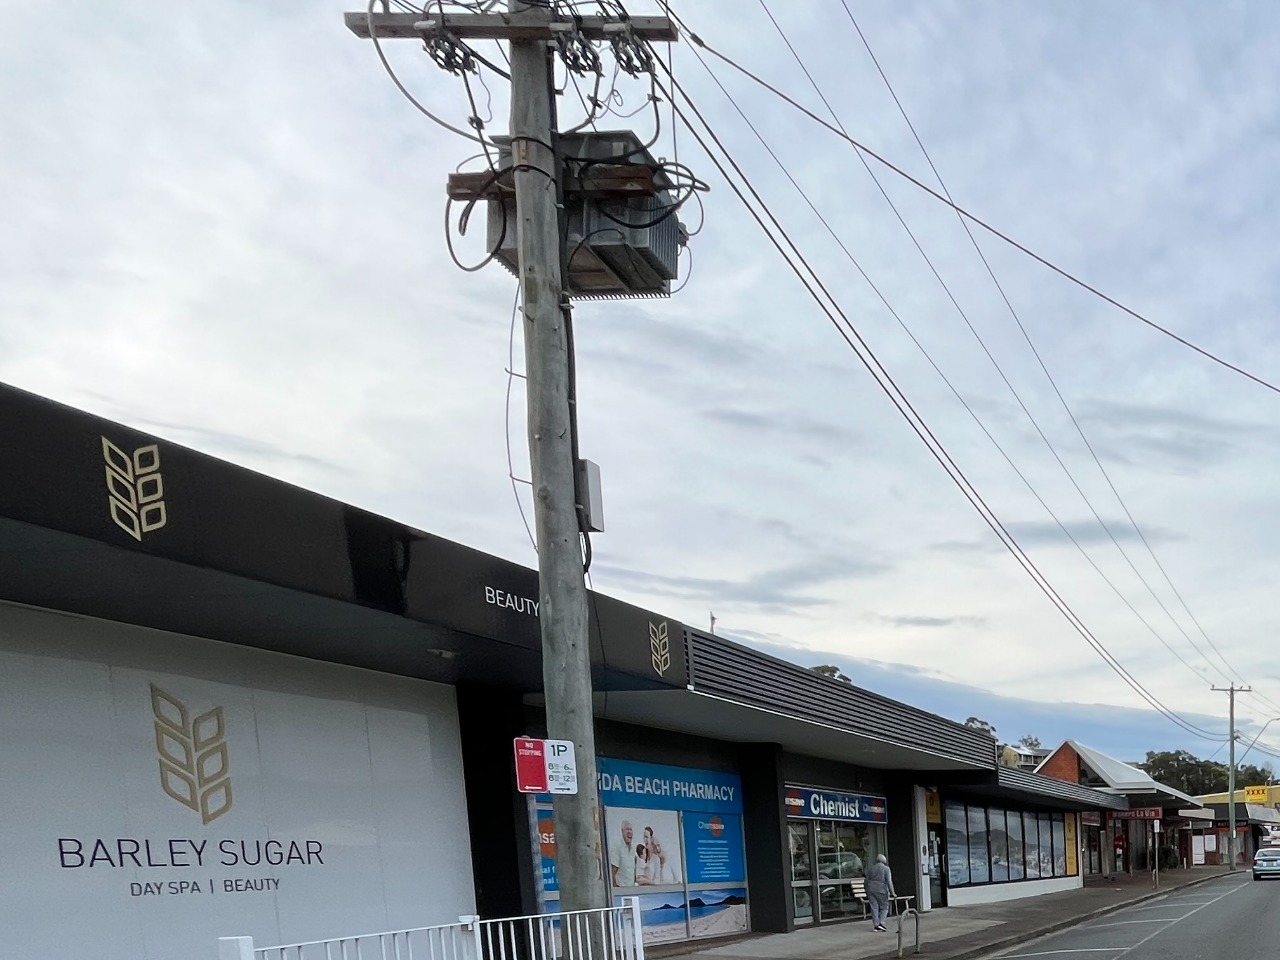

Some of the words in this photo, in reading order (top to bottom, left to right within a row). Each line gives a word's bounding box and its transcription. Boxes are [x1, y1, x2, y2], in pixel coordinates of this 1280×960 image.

[485, 586, 540, 617] BEAUTY
[518, 748, 542, 757] STOPPING
[551, 744, 567, 757] 1P
[624, 775, 670, 796] BEACH
[673, 781, 735, 802] PHARMACY
[810, 793, 860, 818] Chemist
[58, 838, 207, 868] BARLEY
[219, 839, 324, 866] SUGAR
[130, 881, 164, 897] DAY
[168, 880, 202, 895] SPA
[223, 878, 280, 893] BEAUTY
